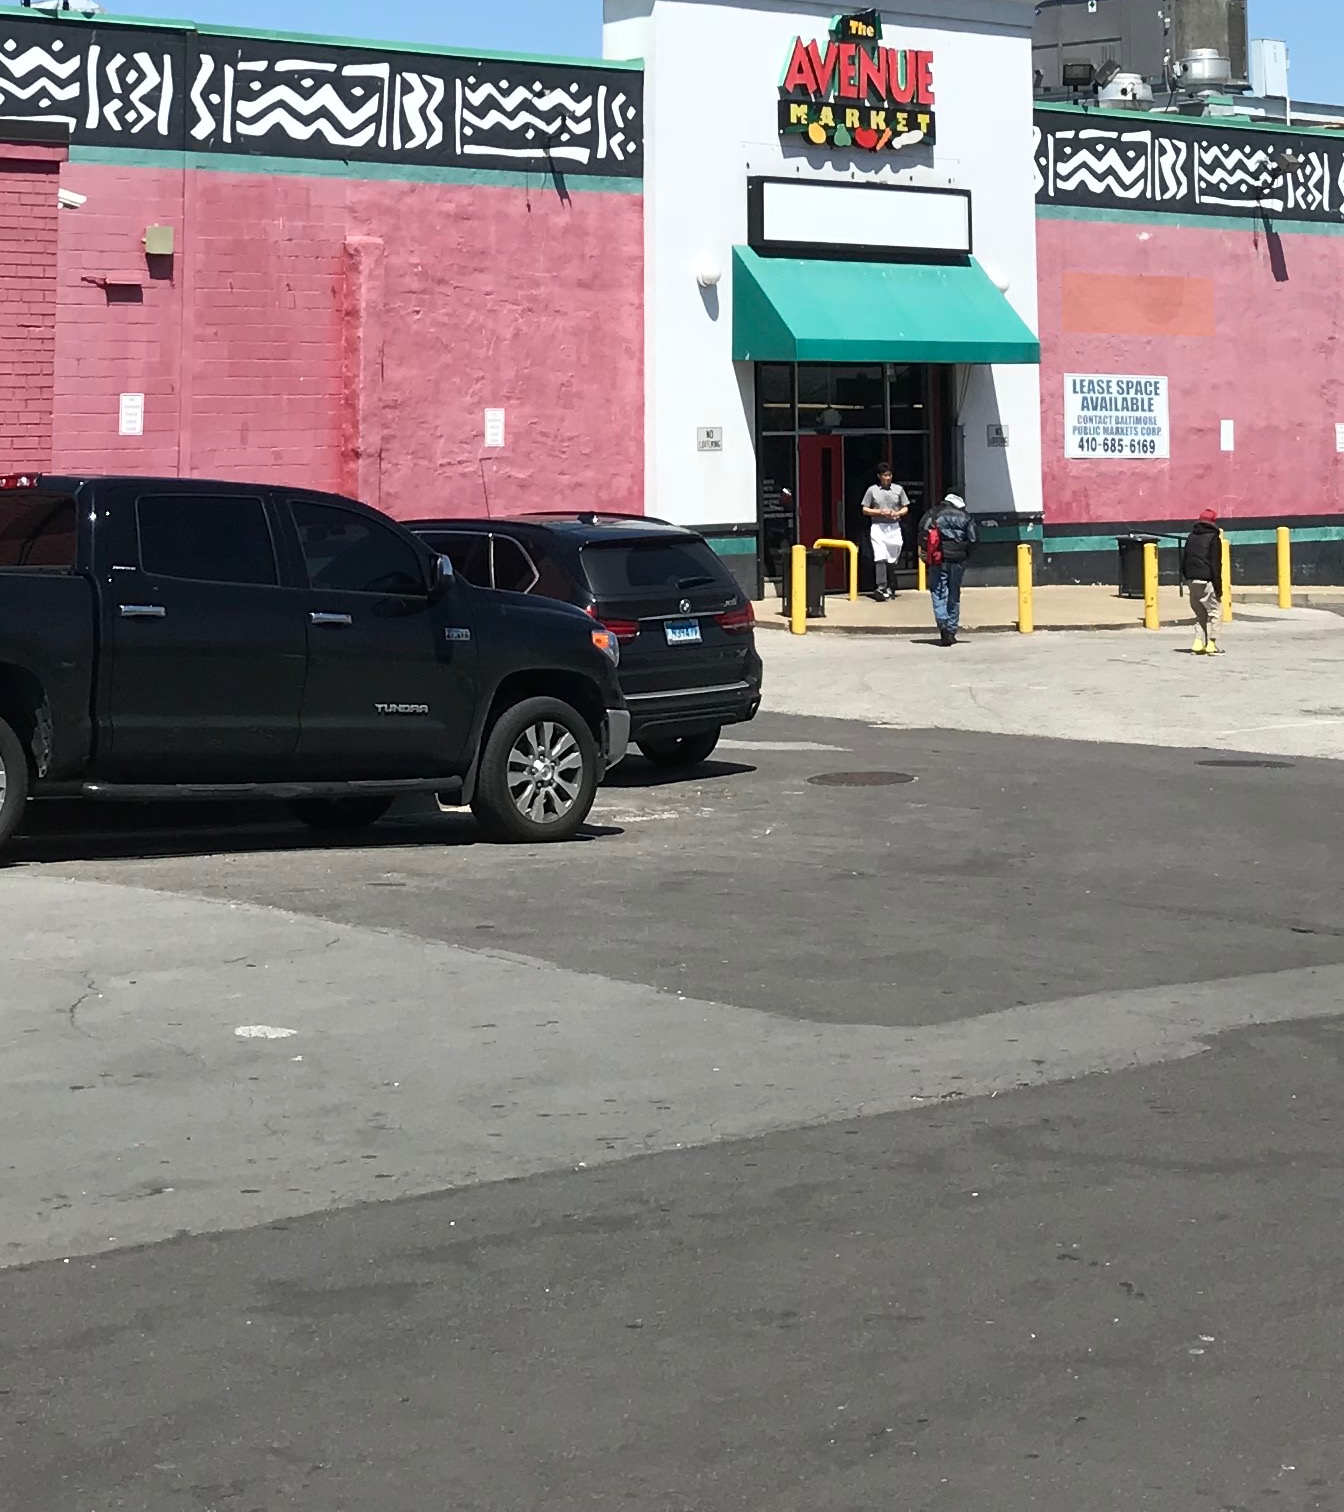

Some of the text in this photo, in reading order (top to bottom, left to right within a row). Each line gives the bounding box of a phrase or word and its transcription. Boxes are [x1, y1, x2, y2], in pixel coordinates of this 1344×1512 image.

[849, 20, 875, 37] The
[784, 36, 935, 105] AVENUE
[789, 103, 930, 134] MARKET
[1072, 379, 1160, 396] LEASE SPACE
[1081, 396, 1154, 412] AVAILABLE
[1077, 415, 1157, 426] CONTACT BALTIMORE
[1072, 425, 1101, 436] PUBLIC
[1102, 426, 1138, 436] MARKETS
[1078, 436, 1156, 454] 410-685-6169
[374, 703, 429, 714] TUNDRA
